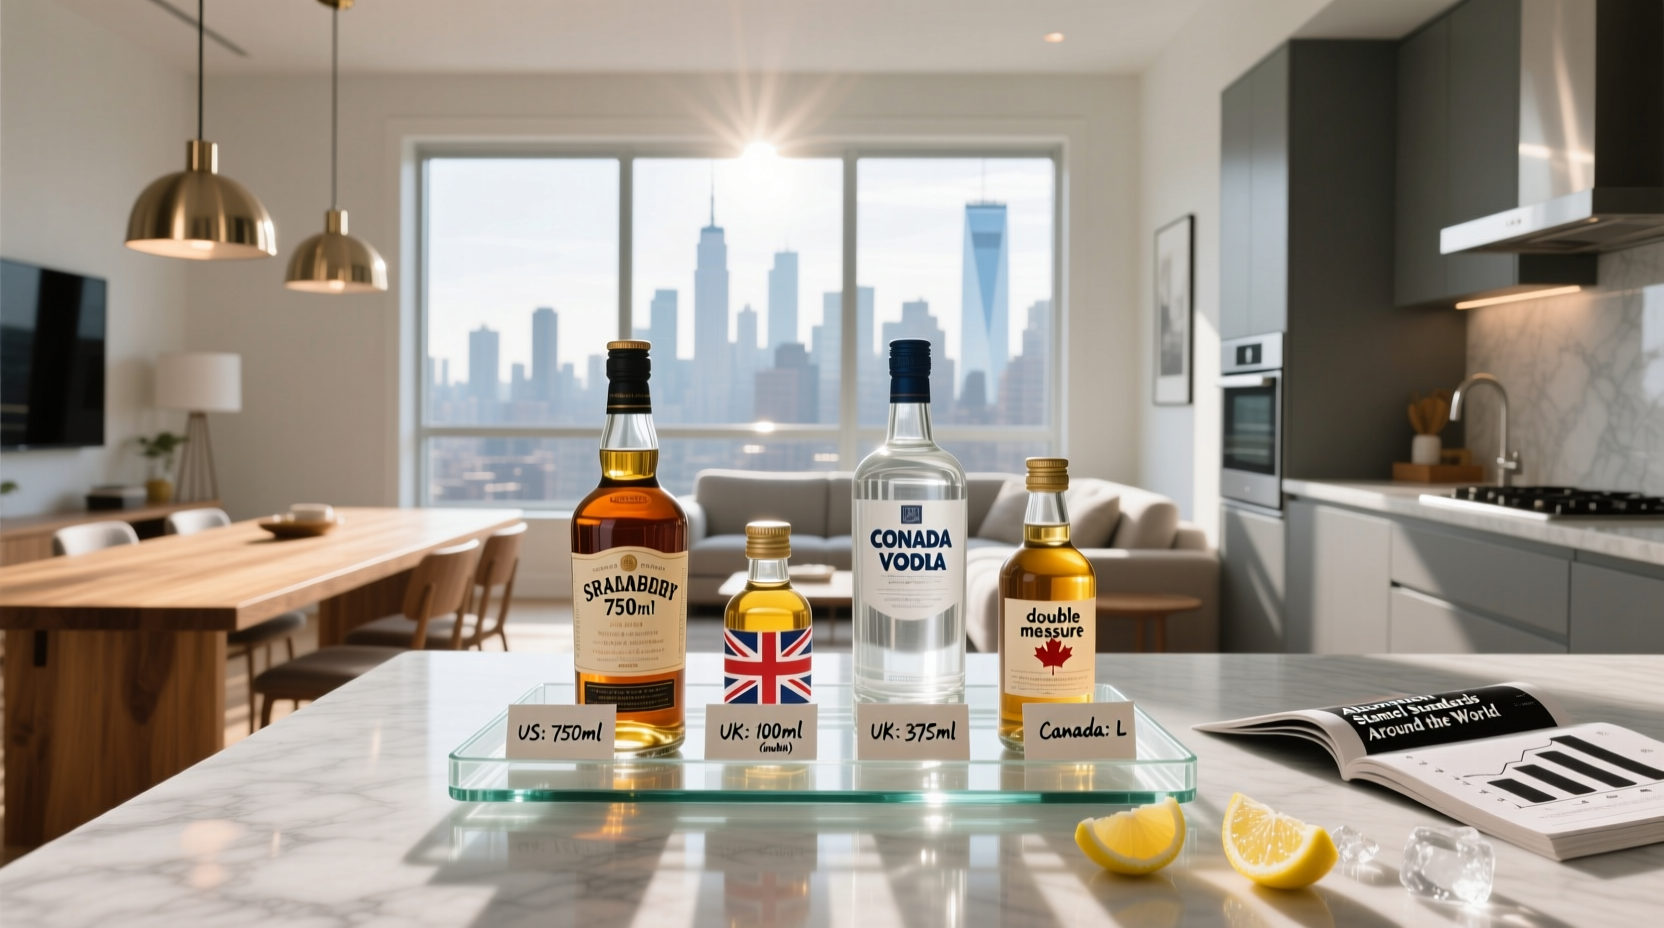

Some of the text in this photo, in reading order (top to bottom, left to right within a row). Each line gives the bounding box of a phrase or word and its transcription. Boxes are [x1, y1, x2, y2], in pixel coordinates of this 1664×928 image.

[870, 528, 953, 549] CONADA
[878, 552, 947, 572] VODLA
[604, 597, 655, 616] 750ml
[1026, 606, 1081, 624] double
[1020, 625, 1084, 639] messure
[518, 721, 603, 743] US: 750ml
[720, 719, 803, 741] UK: 100ml
[870, 720, 956, 743] UK: 375ml
[1039, 716, 1127, 741] Canada: L
[1369, 716, 1425, 741] Around
[1425, 713, 1452, 730] the
[1449, 702, 1502, 725] World
